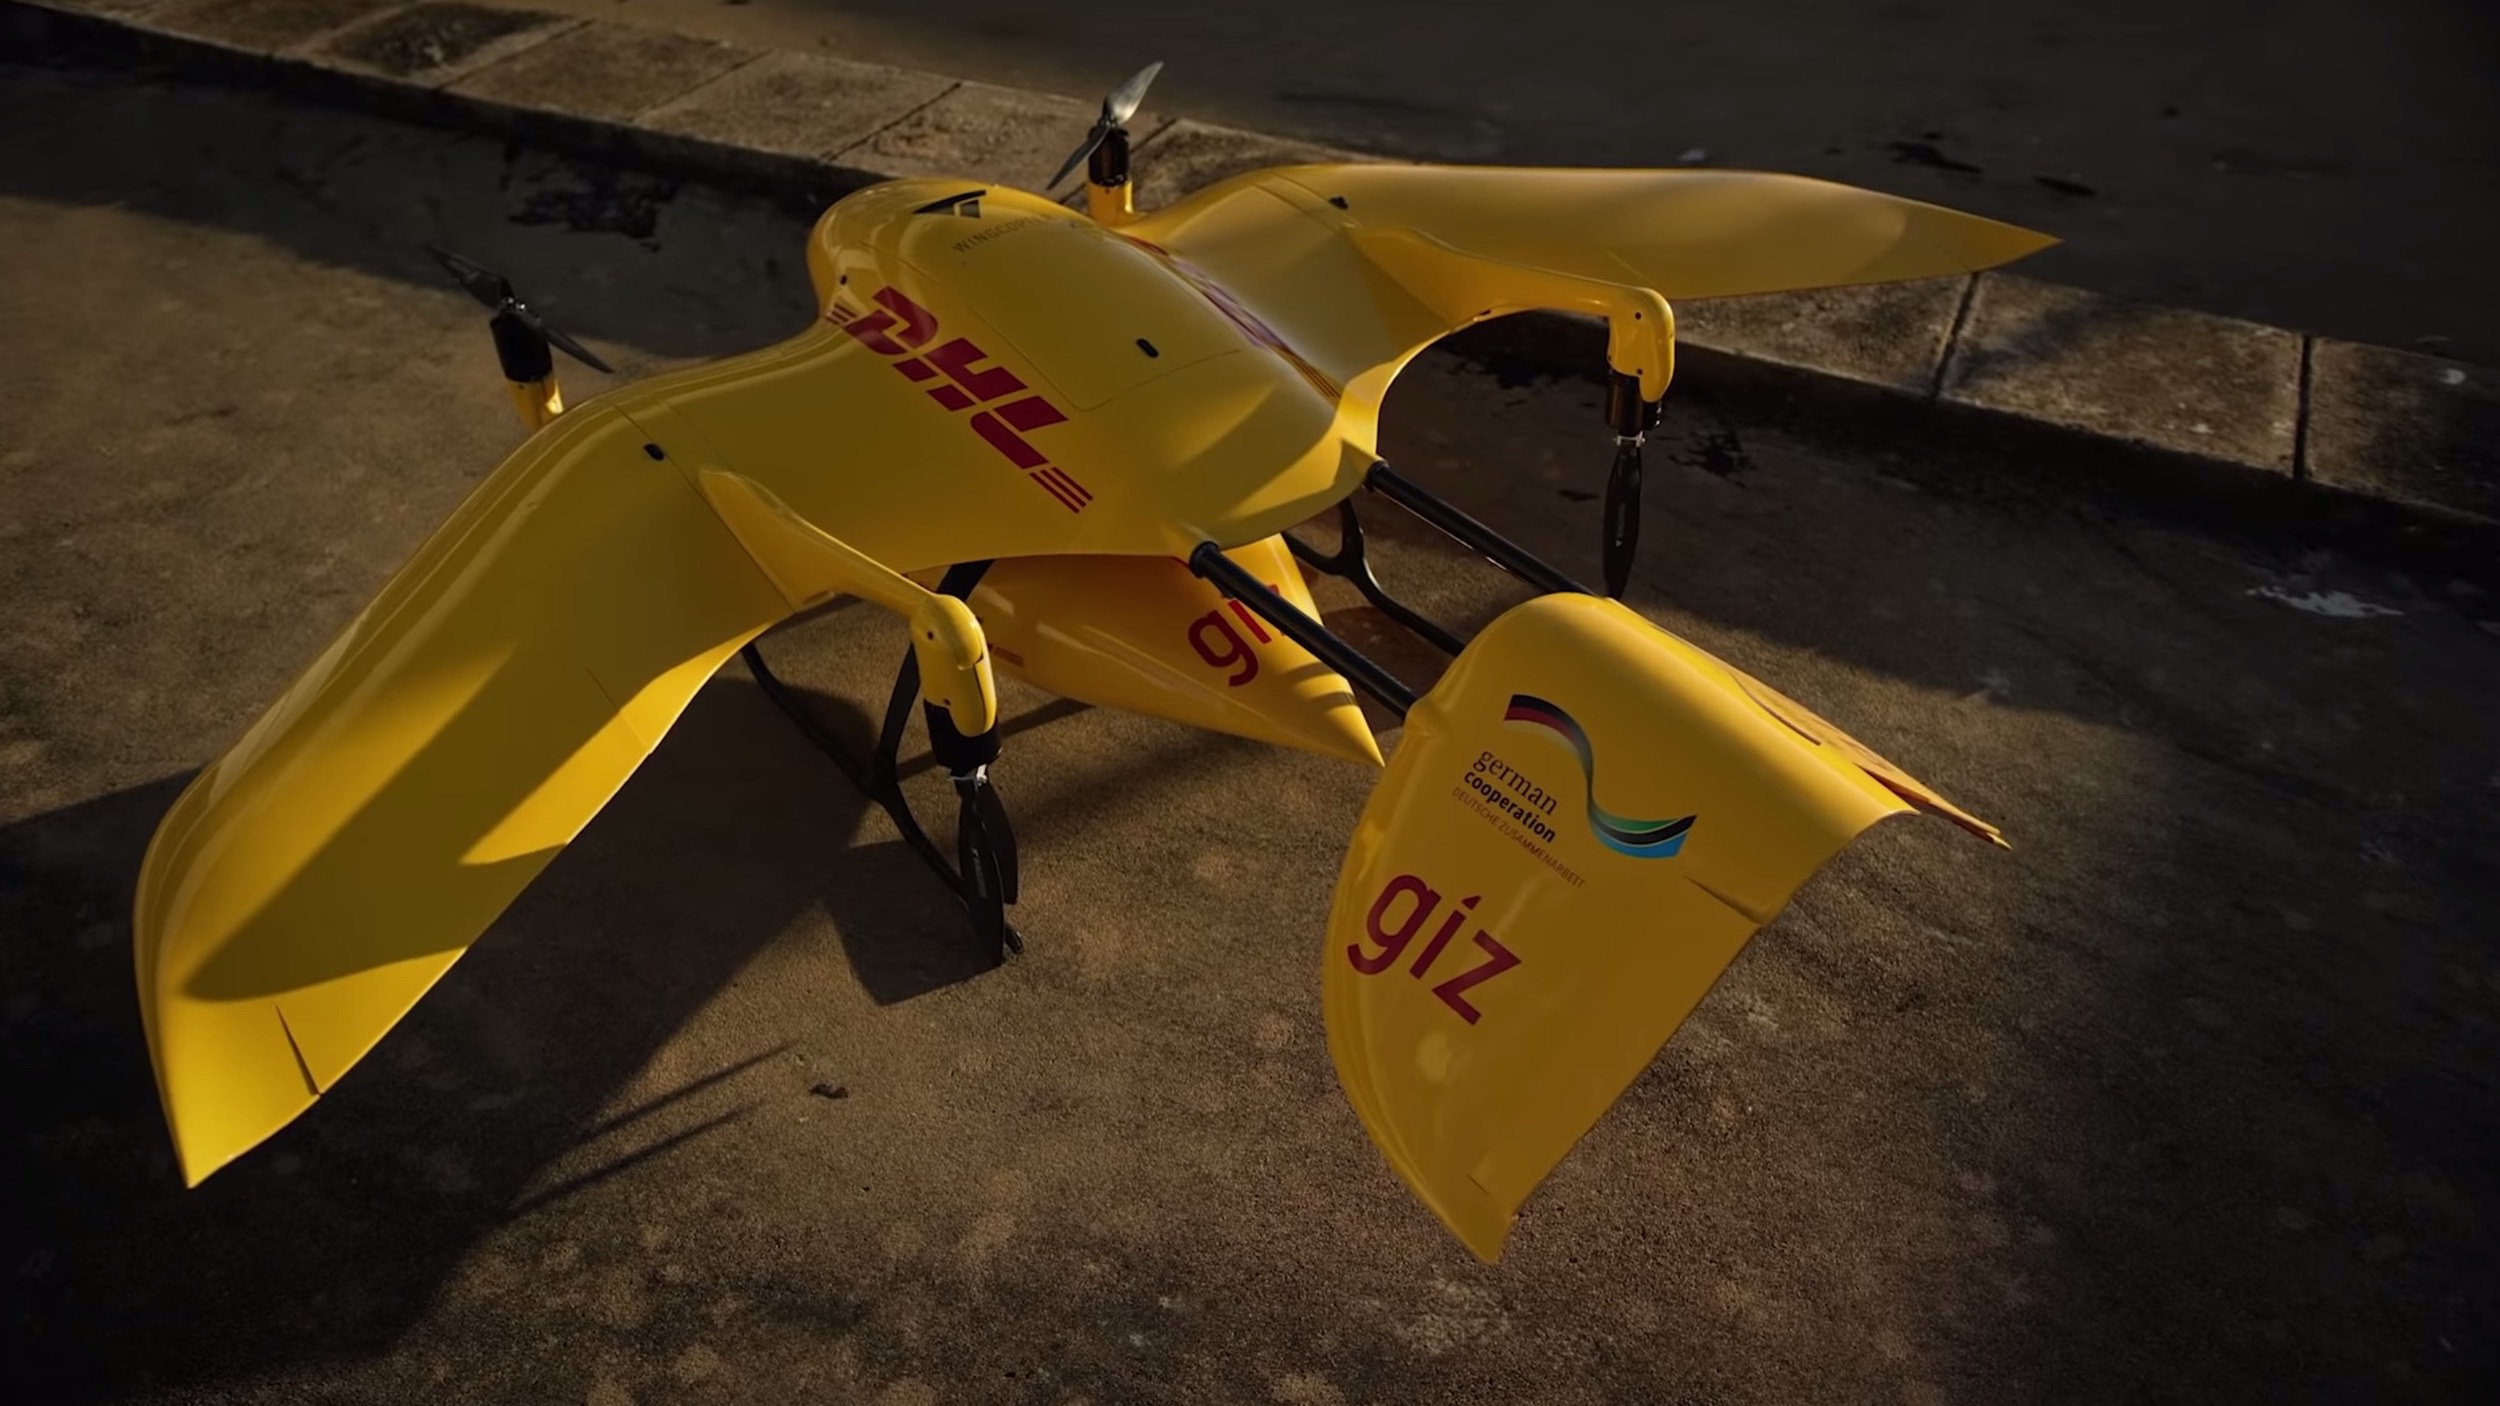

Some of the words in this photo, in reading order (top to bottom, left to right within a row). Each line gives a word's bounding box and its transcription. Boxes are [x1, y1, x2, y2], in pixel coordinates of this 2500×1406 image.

[843, 286, 1069, 470] DHL
[1189, 584, 1285, 686] gi
[1451, 786, 1499, 826] DEUTSCHE
[1464, 771, 1556, 842] cooperation
[1472, 750, 1558, 816] german
[1347, 874, 1522, 1026] giz
